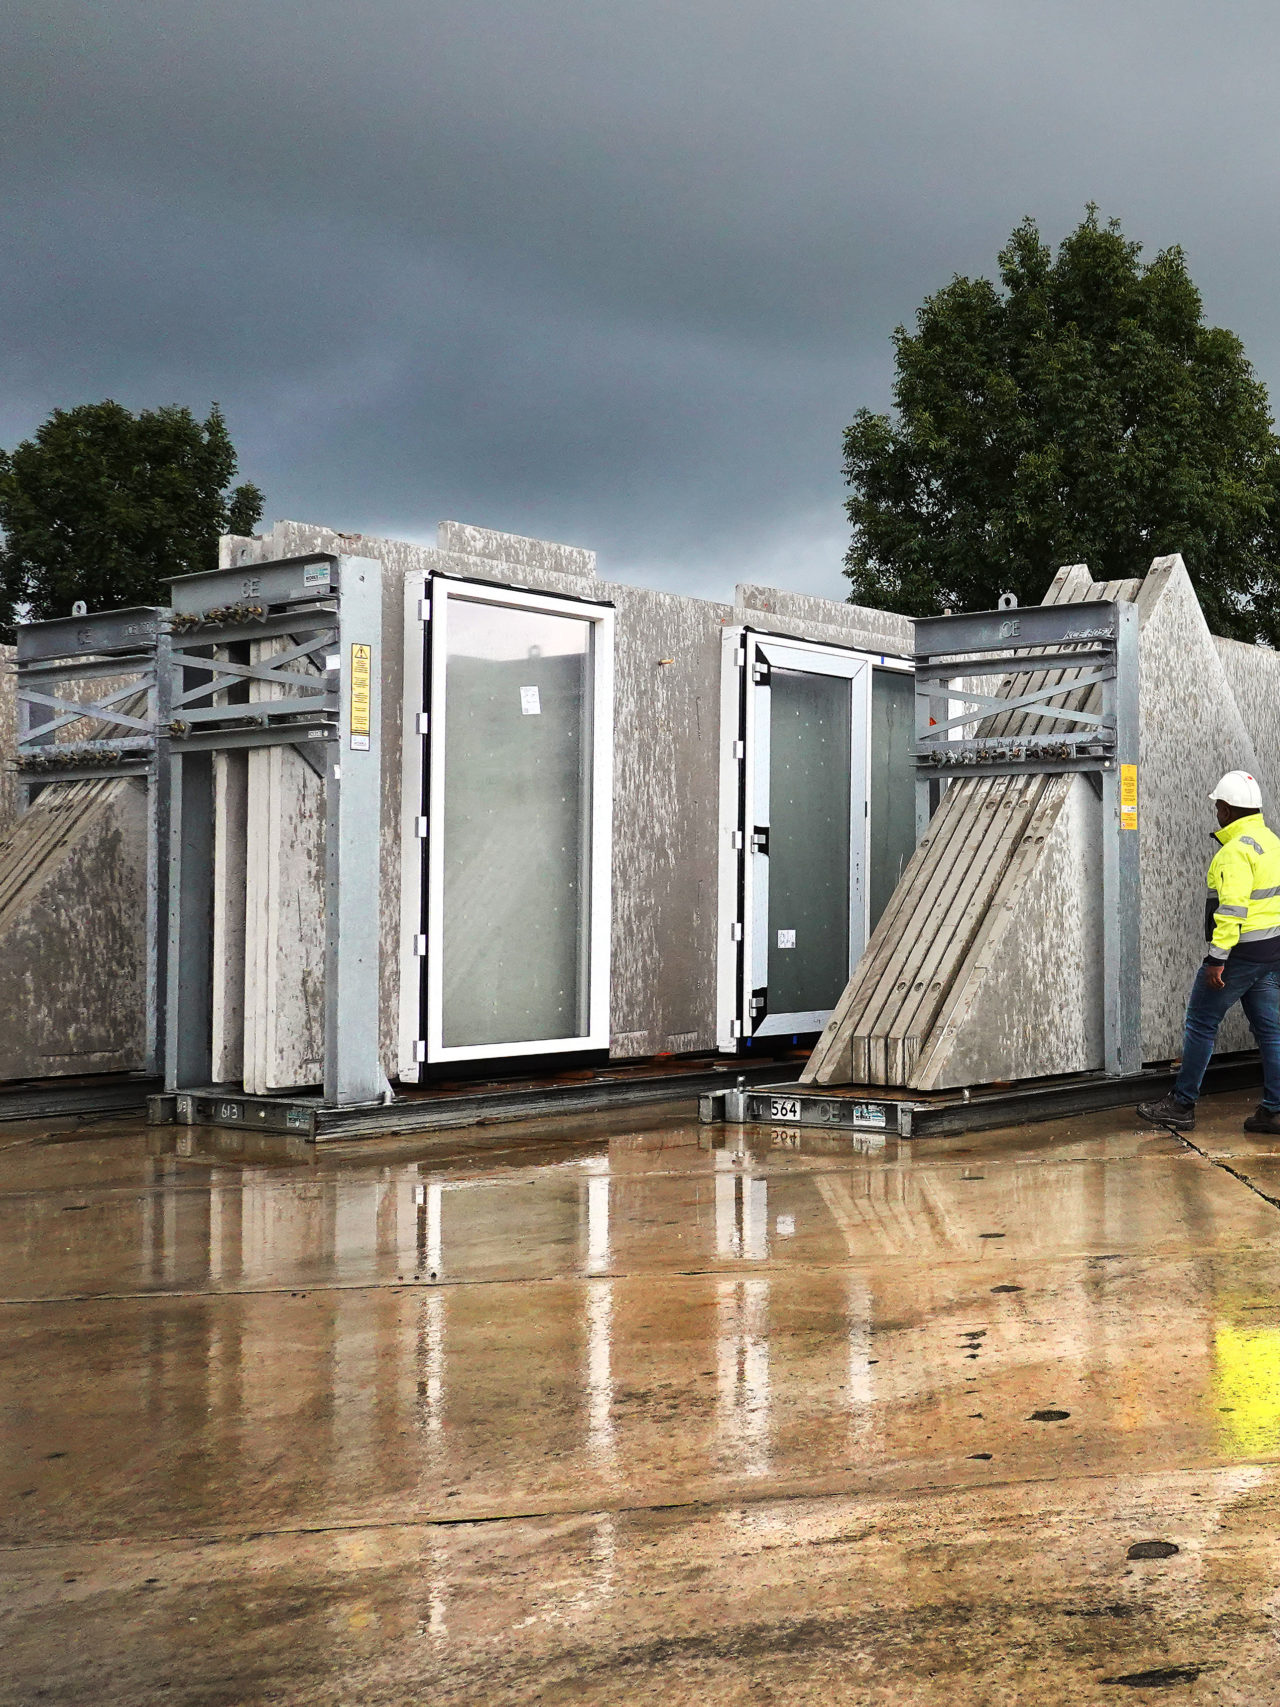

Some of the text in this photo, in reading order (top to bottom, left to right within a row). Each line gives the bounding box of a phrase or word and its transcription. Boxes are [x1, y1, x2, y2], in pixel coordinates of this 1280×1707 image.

[1001, 620, 1021, 638] CE
[221, 1103, 238, 1119] 613
[771, 1101, 797, 1117] 564
